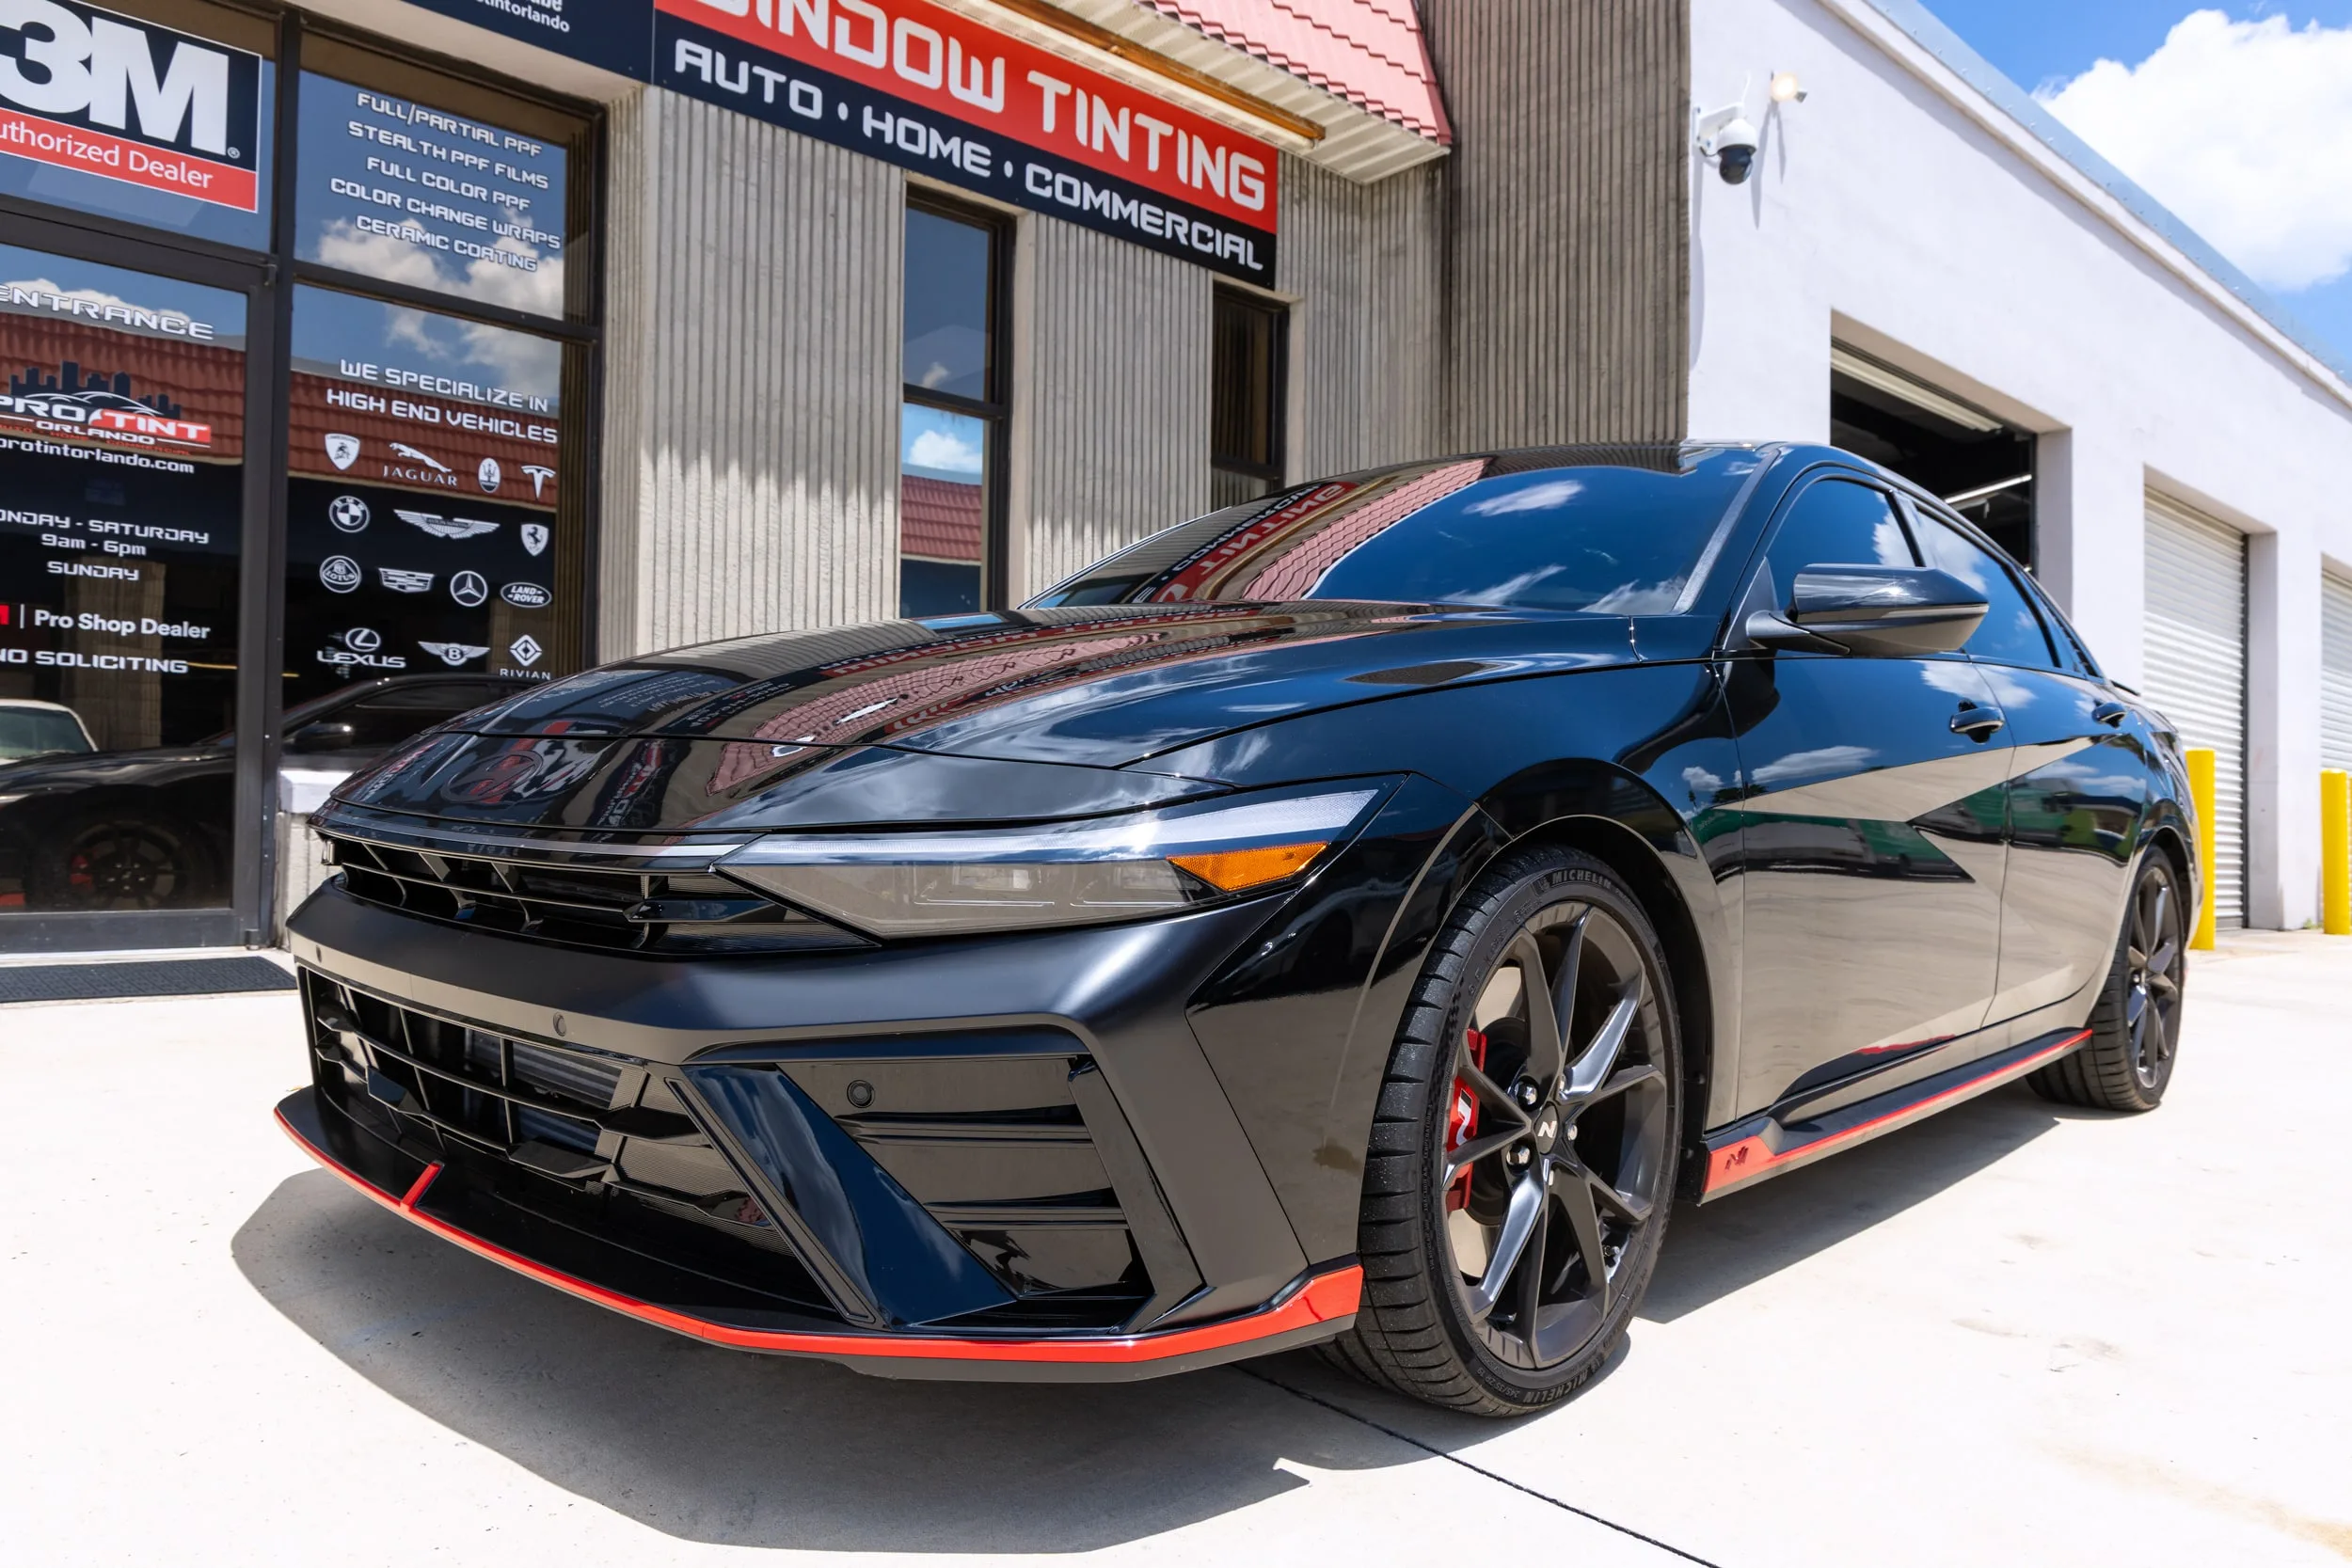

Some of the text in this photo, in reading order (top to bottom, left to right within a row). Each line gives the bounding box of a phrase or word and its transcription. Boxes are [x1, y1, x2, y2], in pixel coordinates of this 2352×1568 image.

[694, 0, 1266, 213] NDOW TINTING
[357, 91, 543, 157] FULL/PARTIAL PPF
[0, 121, 214, 188] uthorized Dealer
[348, 120, 549, 189] STEALTH PPF FILMS
[675, 39, 1264, 271] AUTO HOME COMMERCIAL
[367, 156, 532, 211] FULL COLOR PPF
[330, 177, 561, 249] COLOR CHANGE WRAPS
[356, 214, 537, 272] CERAMIC COATING
[340, 359, 548, 413] WE SPECIALIZE IN
[103, 412, 207, 439] TINT
[326, 388, 558, 444] HIGH END VEHICLES
[36, 420, 155, 445] ORLANDO
[383, 465, 458, 487] JAGUAR
[0, 509, 71, 529] NDAY
[88, 519, 209, 545] SATURDAY
[41, 533, 86, 549] 9am
[103, 540, 147, 558] 6pm
[47, 561, 140, 581] SUNDAY
[326, 570, 356, 581] LOTUS
[511, 585, 537, 594] LAND
[513, 594, 545, 604] ROVER
[34, 610, 211, 639] Pro Shop Dealer
[35, 650, 189, 673] SOLICITING
[316, 650, 407, 669] LEXUS
[500, 668, 551, 681] RIVIAN
[1552, 869, 1612, 890] MICHELIN
[1523, 1369, 1590, 1403] MICHELIN
